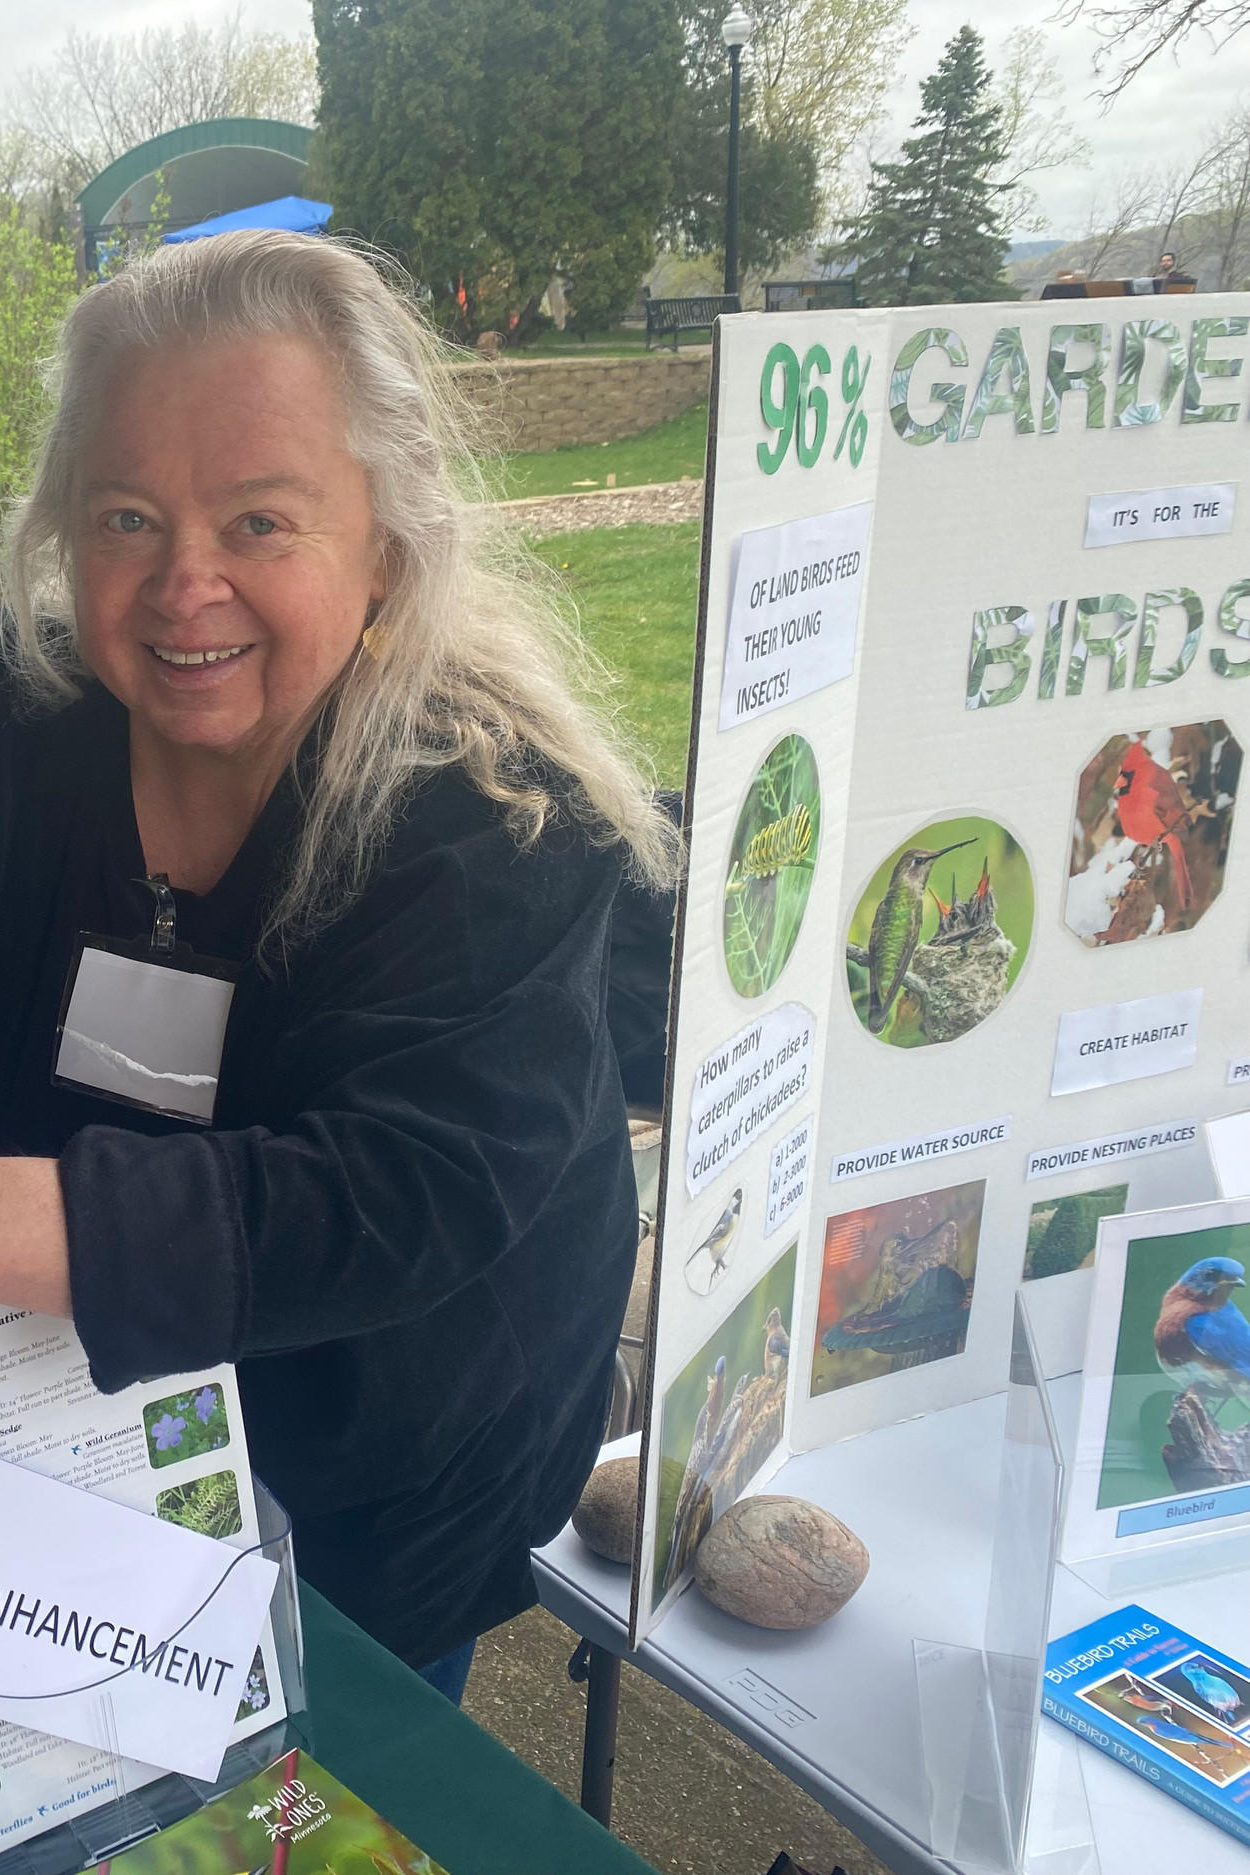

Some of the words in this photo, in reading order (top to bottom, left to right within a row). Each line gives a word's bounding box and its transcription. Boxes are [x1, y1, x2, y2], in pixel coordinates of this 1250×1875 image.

[888, 315, 1250, 446] GARDE
[1113, 509, 1138, 526] IT'S
[1153, 505, 1180, 522] FOR
[1193, 501, 1220, 518] THE
[750, 579, 767, 609] OF
[768, 569, 798, 603] LAND
[800, 558, 834, 592] BIRDS
[834, 550, 860, 580] FEED
[744, 626, 778, 662] THEIR
[780, 610, 821, 648] YOUNG
[966, 577, 1250, 711] BIRDS
[736, 673, 789, 715] INSECTS!
[700, 1052, 729, 1087] How
[731, 1026, 762, 1065] many
[1079, 1034, 1129, 1056] CREATE
[1131, 1023, 1188, 1046] HABITAT
[698, 1069, 760, 1134] caterpillars
[763, 1058, 773, 1080] to
[775, 1037, 800, 1069] raise
[802, 1030, 808, 1046] a
[692, 1133, 728, 1179] clutch
[731, 1120, 742, 1146] of
[744, 1065, 806, 1134] chickadees?
[837, 1150, 897, 1176] PROVIDE
[901, 1138, 948, 1161] WATER
[951, 1124, 1004, 1149] SOURCE
[1031, 1148, 1089, 1172] PROVIDE
[1091, 1136, 1147, 1159] NESTING
[1149, 1126, 1195, 1146] PLACES
[1166, 1498, 1216, 1518] Bluebird
[1043, 1644, 1114, 1683] BLUEBIRD
[1108, 1623, 1159, 1650] TRAILS
[1043, 1698, 1110, 1747] BLUEBIRD
[1112, 1740, 1161, 1781] TRAILS
[52, 1794, 75, 1810] Good
[76, 1790, 90, 1799] for
[91, 1779, 116, 1793] birds
[267, 1779, 306, 1811] WILD
[286, 1792, 326, 1827] ONES
[290, 1813, 332, 1844] Minnesota
